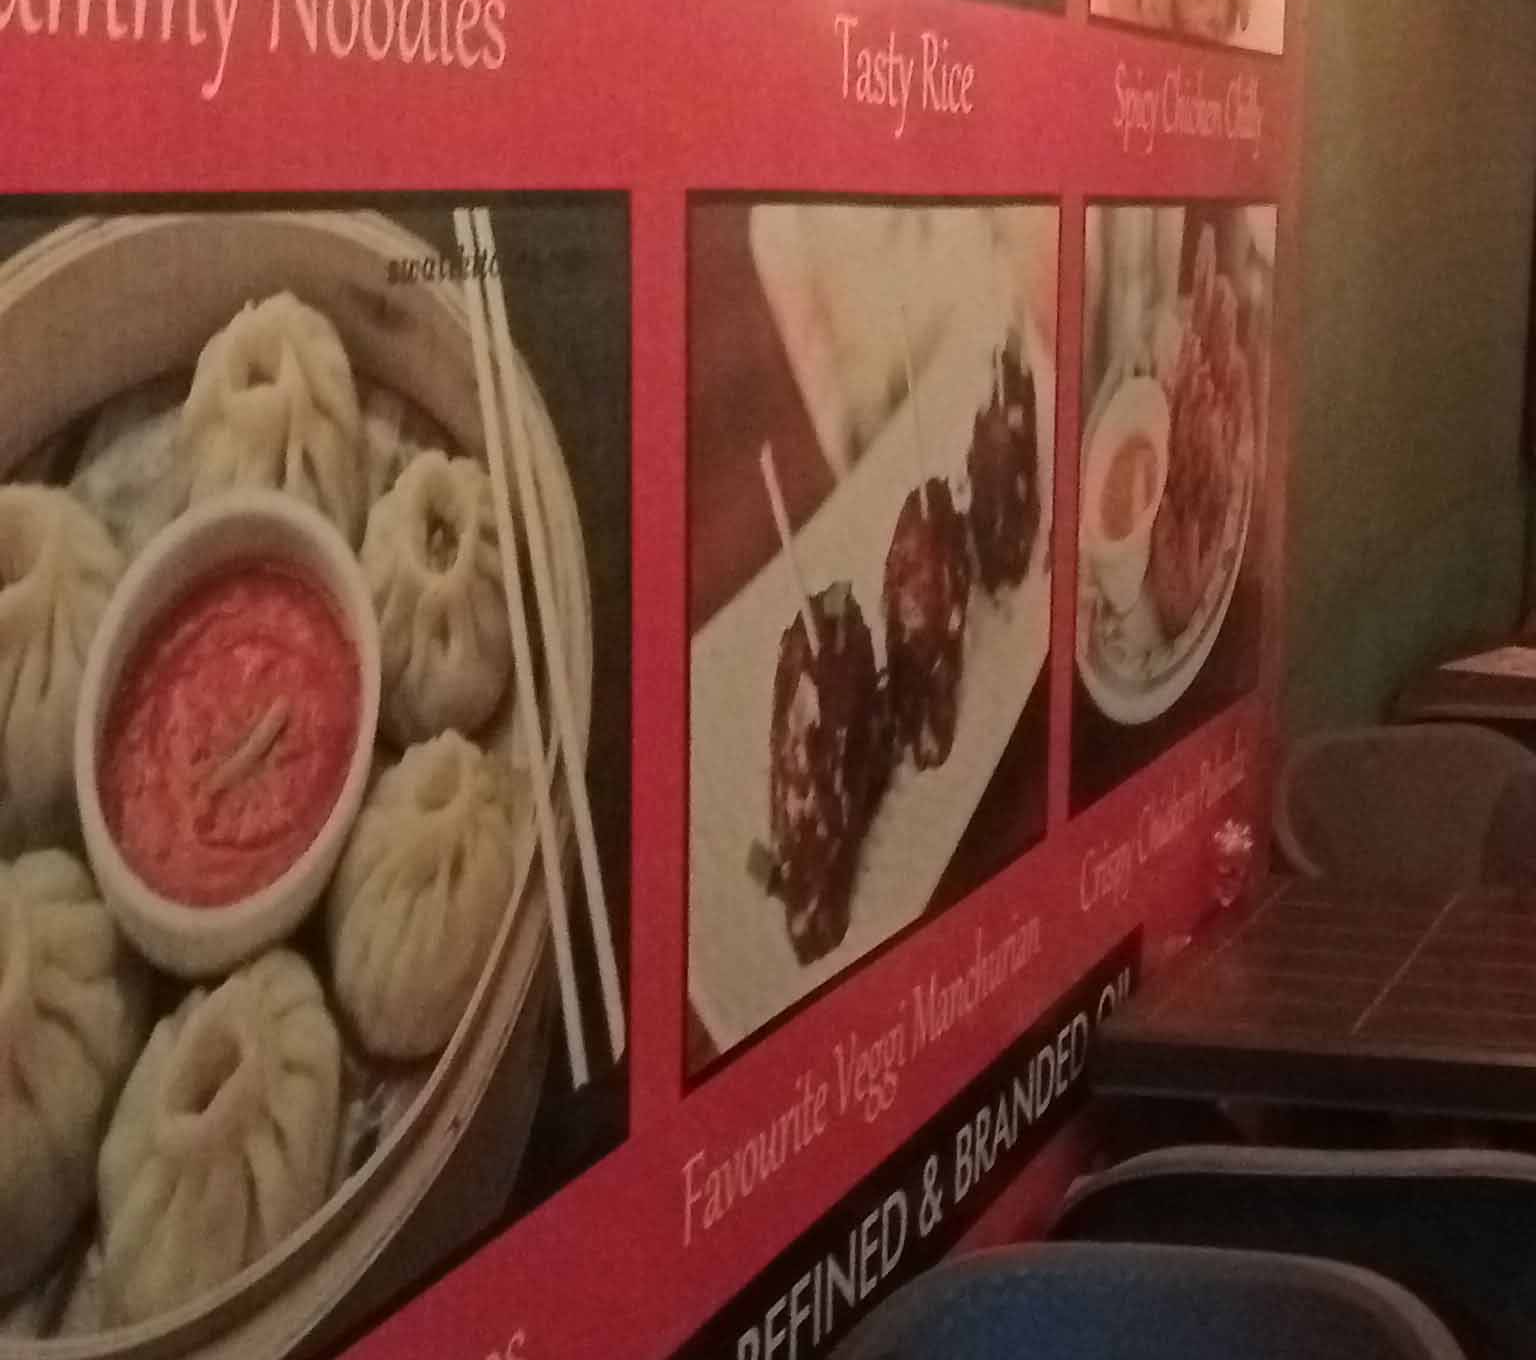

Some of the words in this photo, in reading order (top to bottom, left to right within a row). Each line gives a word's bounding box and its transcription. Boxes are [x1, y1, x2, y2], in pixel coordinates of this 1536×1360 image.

[834, 13, 915, 138] Tasty
[921, 31, 976, 116] Rice
[682, 1069, 829, 1248] Favourite
[911, 914, 1041, 1059] Manchurian
[918, 1154, 944, 1238] &
[953, 1013, 1089, 1204] BRANDED
